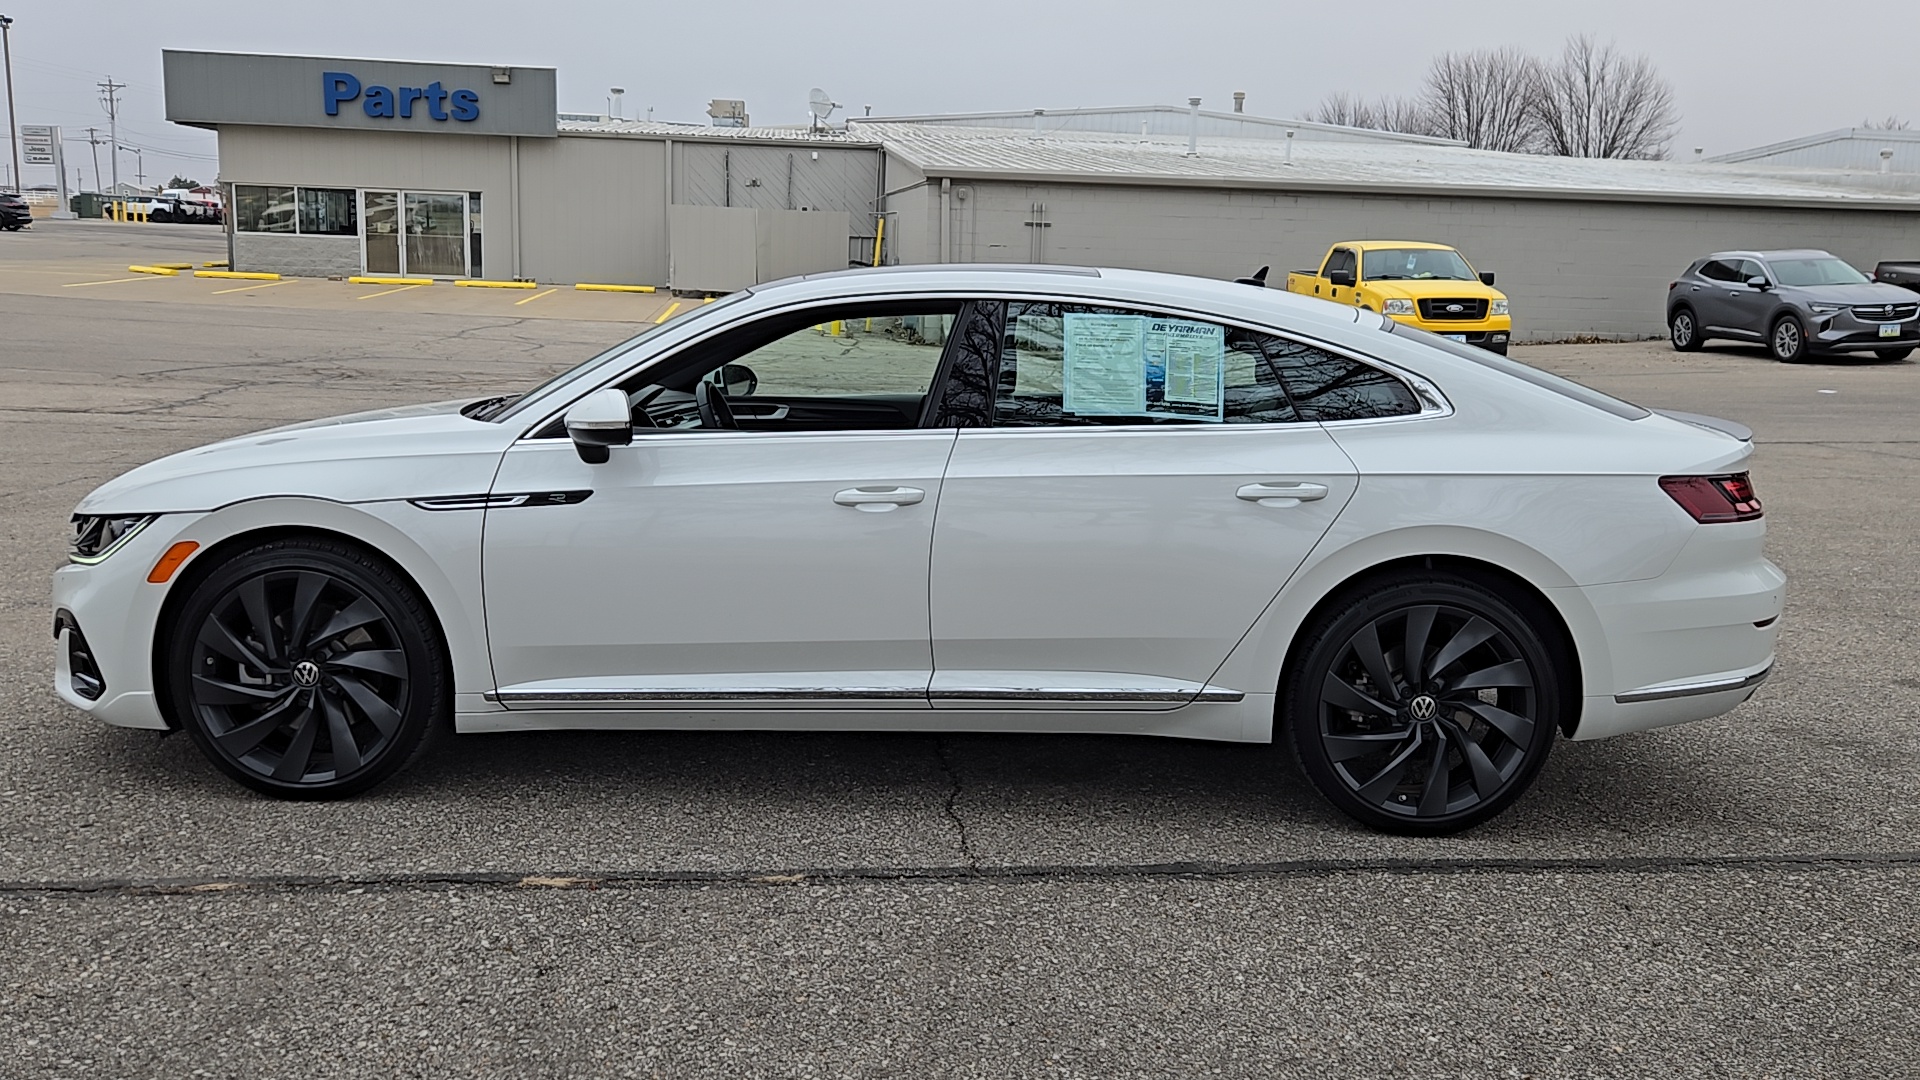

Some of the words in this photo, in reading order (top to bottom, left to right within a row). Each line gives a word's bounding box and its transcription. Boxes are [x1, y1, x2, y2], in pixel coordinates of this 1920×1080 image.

[323, 71, 480, 122] Parts
[28, 145, 46, 153] Jeep
[1151, 323, 1216, 335] DEYARMAN
